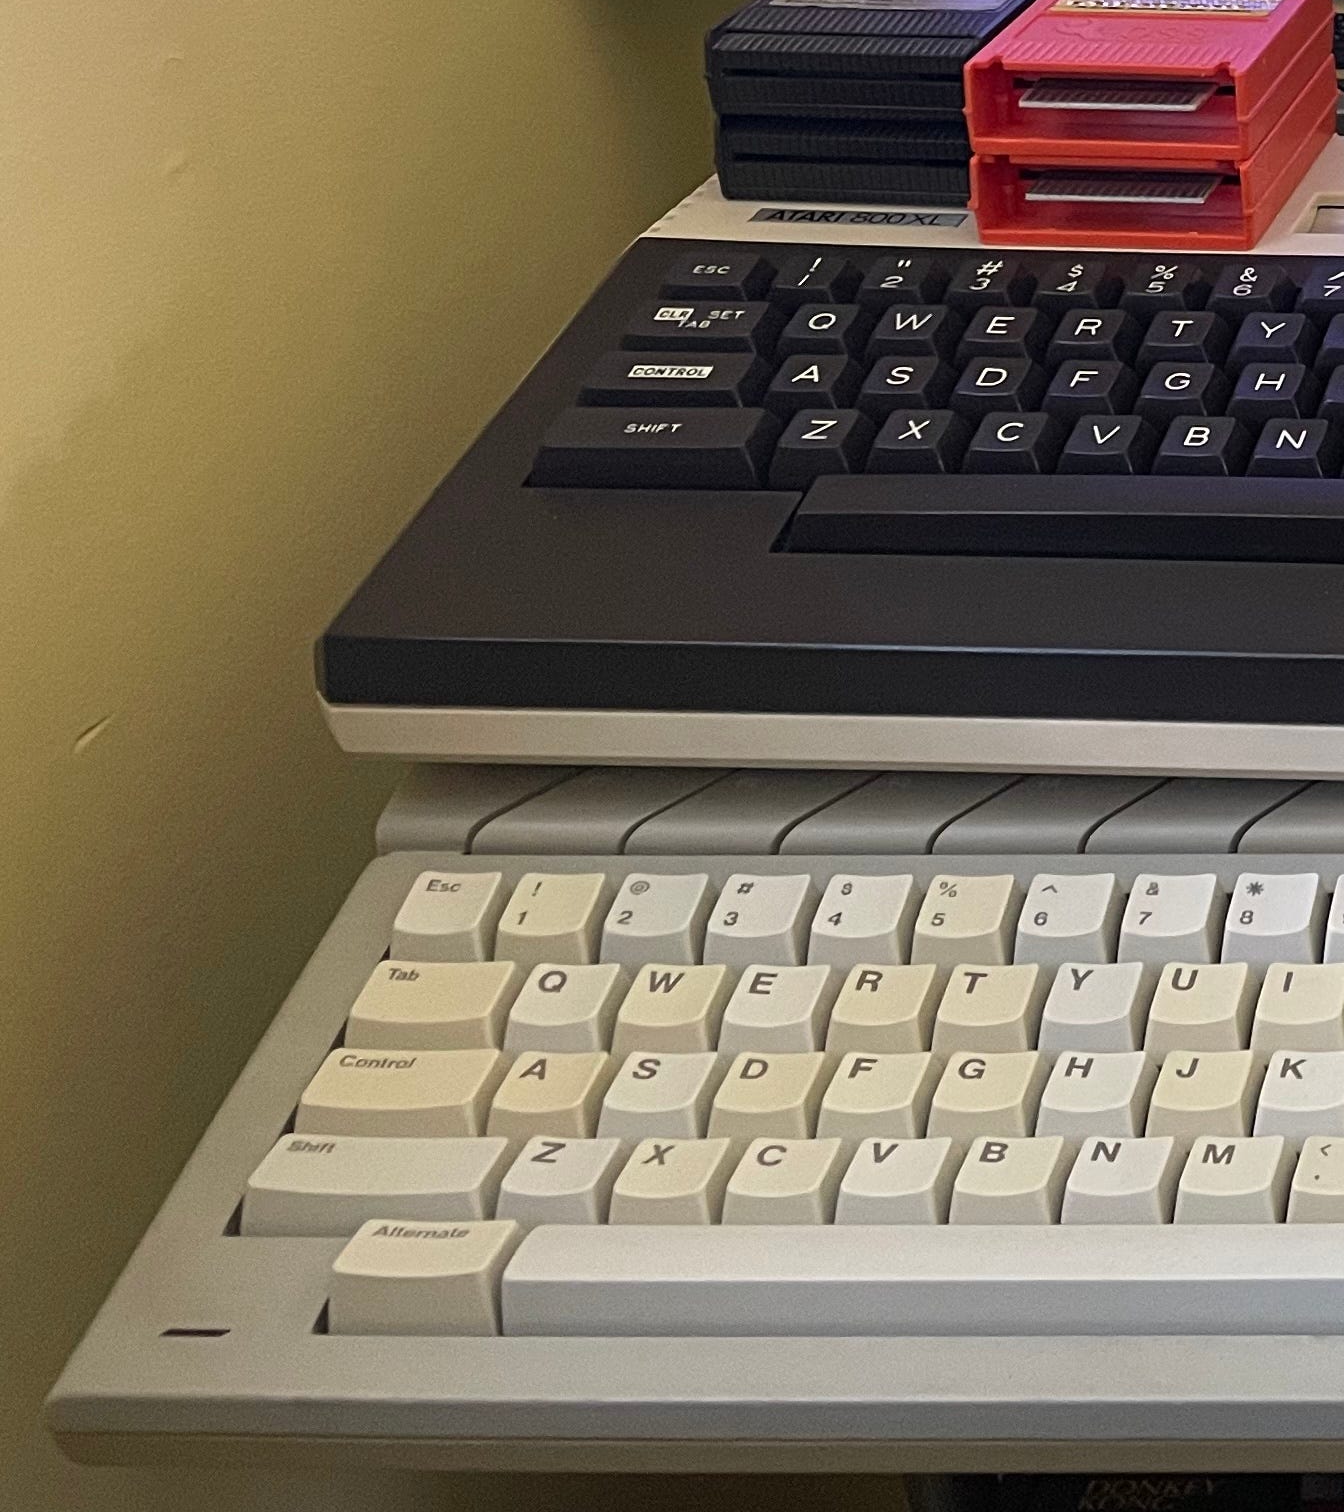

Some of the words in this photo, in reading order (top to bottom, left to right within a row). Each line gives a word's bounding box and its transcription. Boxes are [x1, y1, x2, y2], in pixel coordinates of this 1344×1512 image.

[766, 210, 845, 222] ATARI
[693, 265, 730, 275] ESC
[657, 310, 689, 320] CLR
[708, 310, 745, 320] SET
[678, 320, 711, 329] TAB
[808, 312, 836, 330] Q
[895, 312, 933, 330] W
[986, 316, 1015, 334] E
[1074, 318, 1102, 336] R
[1172, 320, 1194, 337] T
[1260, 321, 1286, 339] Y
[632, 367, 708, 377] CONTROL
[791, 365, 819, 383] A
[886, 366, 914, 385] S
[975, 367, 1007, 386] D
[1069, 370, 1099, 387] F
[1164, 372, 1191, 390] G
[1254, 373, 1286, 391] H
[624, 423, 682, 434] SHIFT
[801, 419, 838, 440] Z
[898, 420, 930, 440] X
[997, 422, 1024, 442] C
[1093, 425, 1121, 444] V
[1183, 426, 1210, 446] B
[1275, 429, 1307, 449] N
[426, 879, 462, 894] Esc
[388, 966, 420, 983] Tab
[538, 970, 568, 993] Q
[649, 970, 685, 994] W
[748, 972, 778, 995] E
[855, 970, 884, 993] R
[963, 971, 988, 994] T
[1071, 968, 1094, 991] Y
[1171, 967, 1199, 991] U
[1283, 971, 1294, 993] I
[338, 1055, 417, 1071] Control
[519, 1058, 547, 1081] A
[632, 1058, 662, 1080] S
[739, 1058, 769, 1080] D
[848, 1057, 878, 1079] F
[958, 1058, 987, 1080] G
[1064, 1056, 1094, 1079] H
[1175, 1057, 1200, 1079] J
[1280, 1057, 1307, 1080] K
[286, 1139, 335, 1155] Shift
[530, 1141, 567, 1164] Z
[642, 1144, 675, 1166] X
[756, 1144, 788, 1167] C
[873, 1142, 899, 1164] V
[979, 1141, 1009, 1163] B
[1090, 1141, 1123, 1163] N
[1201, 1143, 1236, 1165] M
[371, 1224, 469, 1240] Alternate
